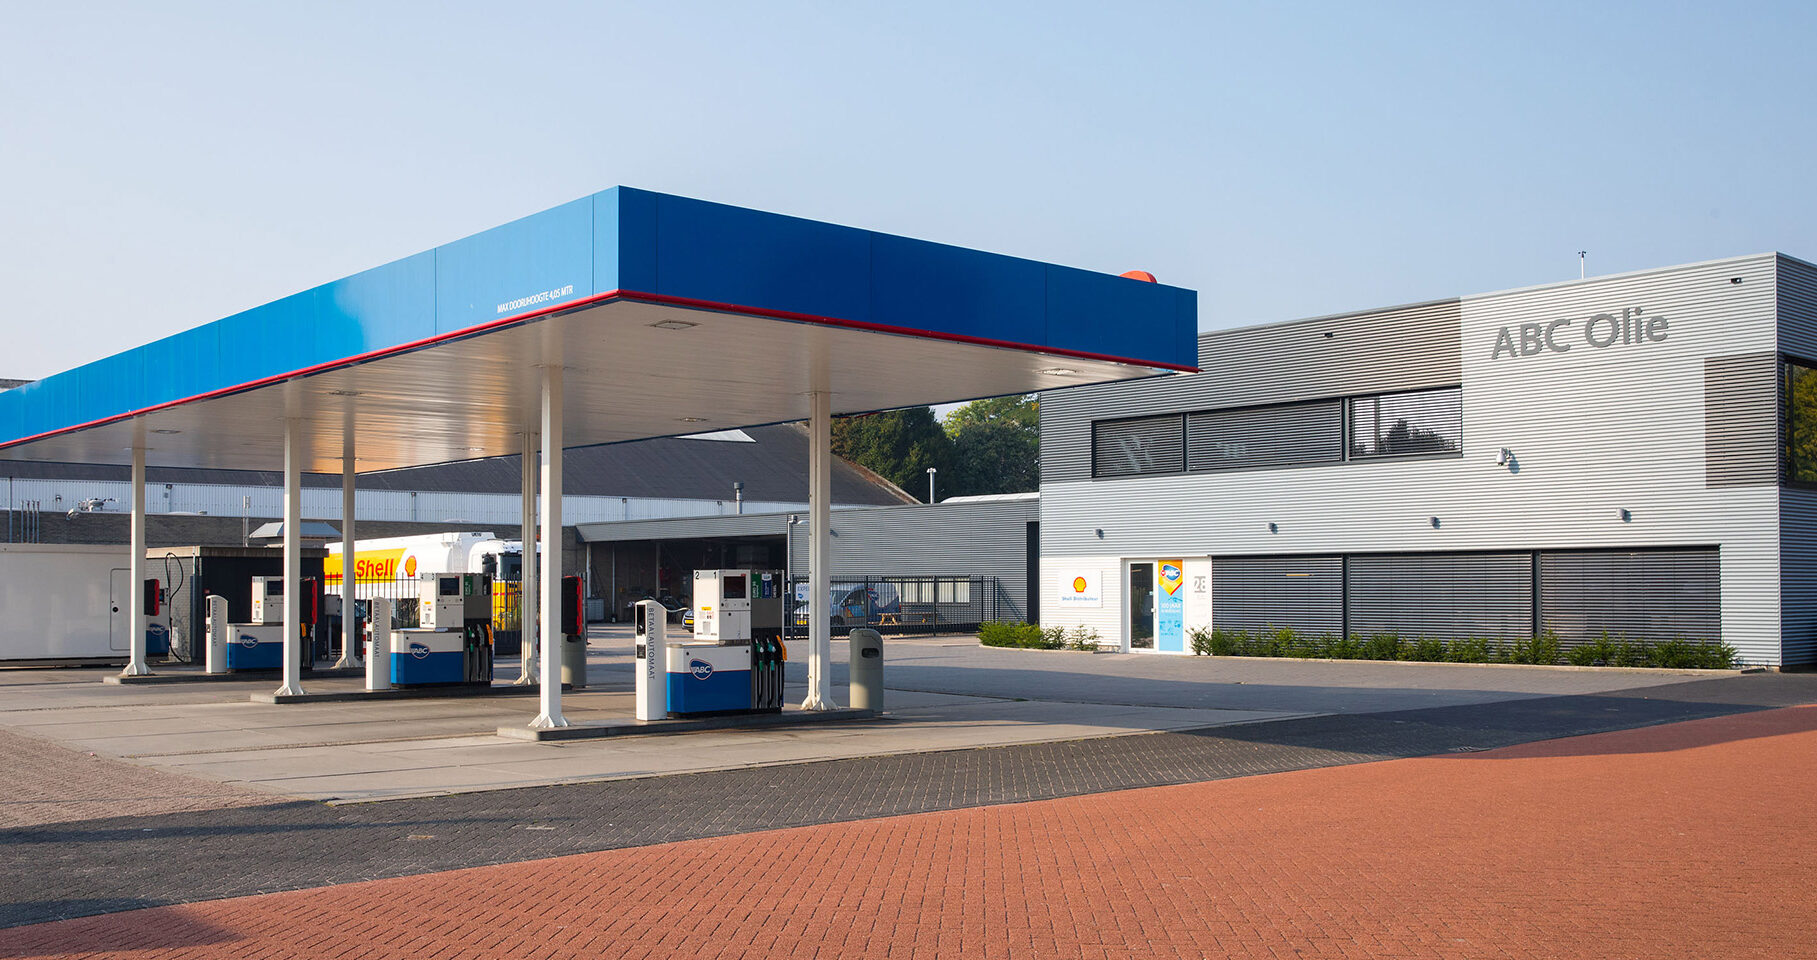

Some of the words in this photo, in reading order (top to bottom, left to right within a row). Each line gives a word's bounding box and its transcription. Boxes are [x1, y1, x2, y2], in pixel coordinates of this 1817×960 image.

[497, 303, 509, 313] MAX
[561, 284, 574, 296] MTR
[1491, 318, 1571, 360] ABC
[1584, 306, 1669, 348] Olie
[356, 558, 394, 577] Shell
[695, 571, 700, 580] 2
[713, 571, 717, 579] 1
[1194, 576, 1206, 593] 28
[694, 666, 711, 674] ABC
